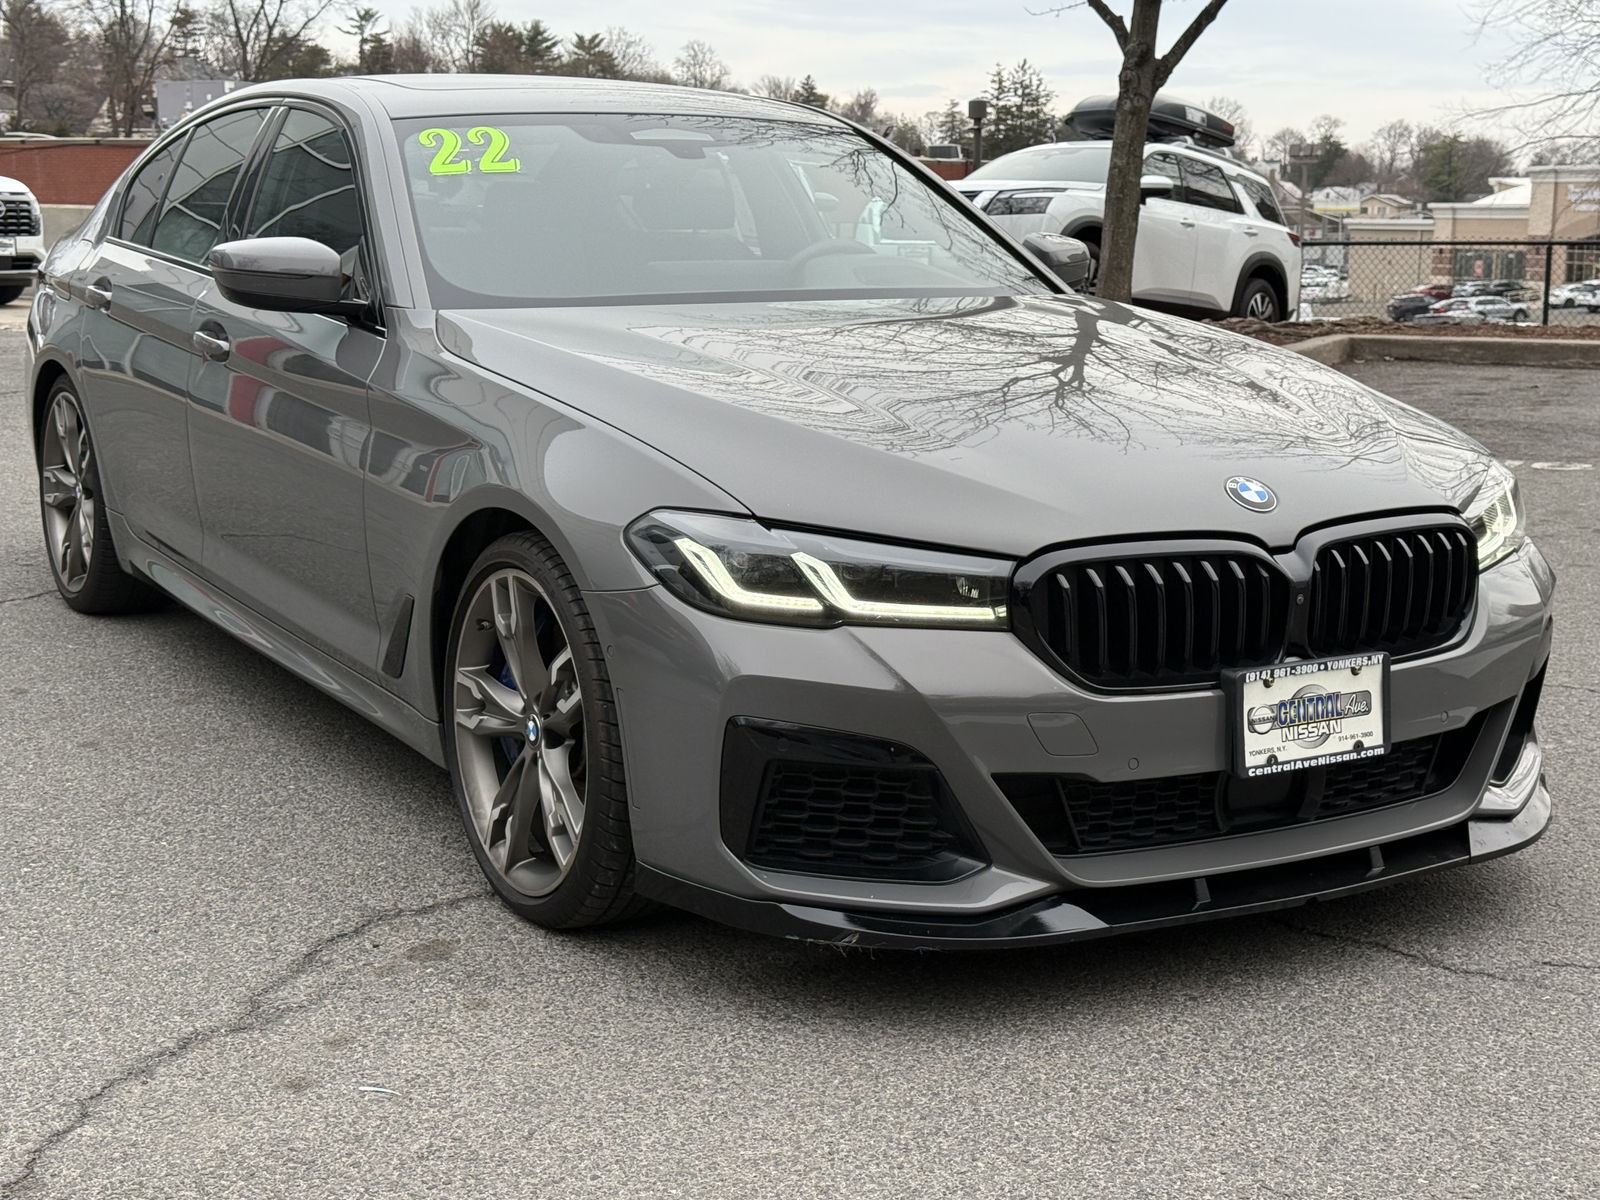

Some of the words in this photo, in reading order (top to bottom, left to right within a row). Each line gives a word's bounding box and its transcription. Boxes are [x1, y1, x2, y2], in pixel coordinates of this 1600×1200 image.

[419, 127, 521, 176] 22
[1274, 664, 1319, 678] 961-3900
[1251, 715, 1275, 723] NISSAN
[1278, 691, 1343, 726] CENTRAL
[1345, 694, 1369, 714] Ave.
[1281, 720, 1342, 742] NISSAN
[1248, 747, 1385, 777] CentralAveNissan.com
